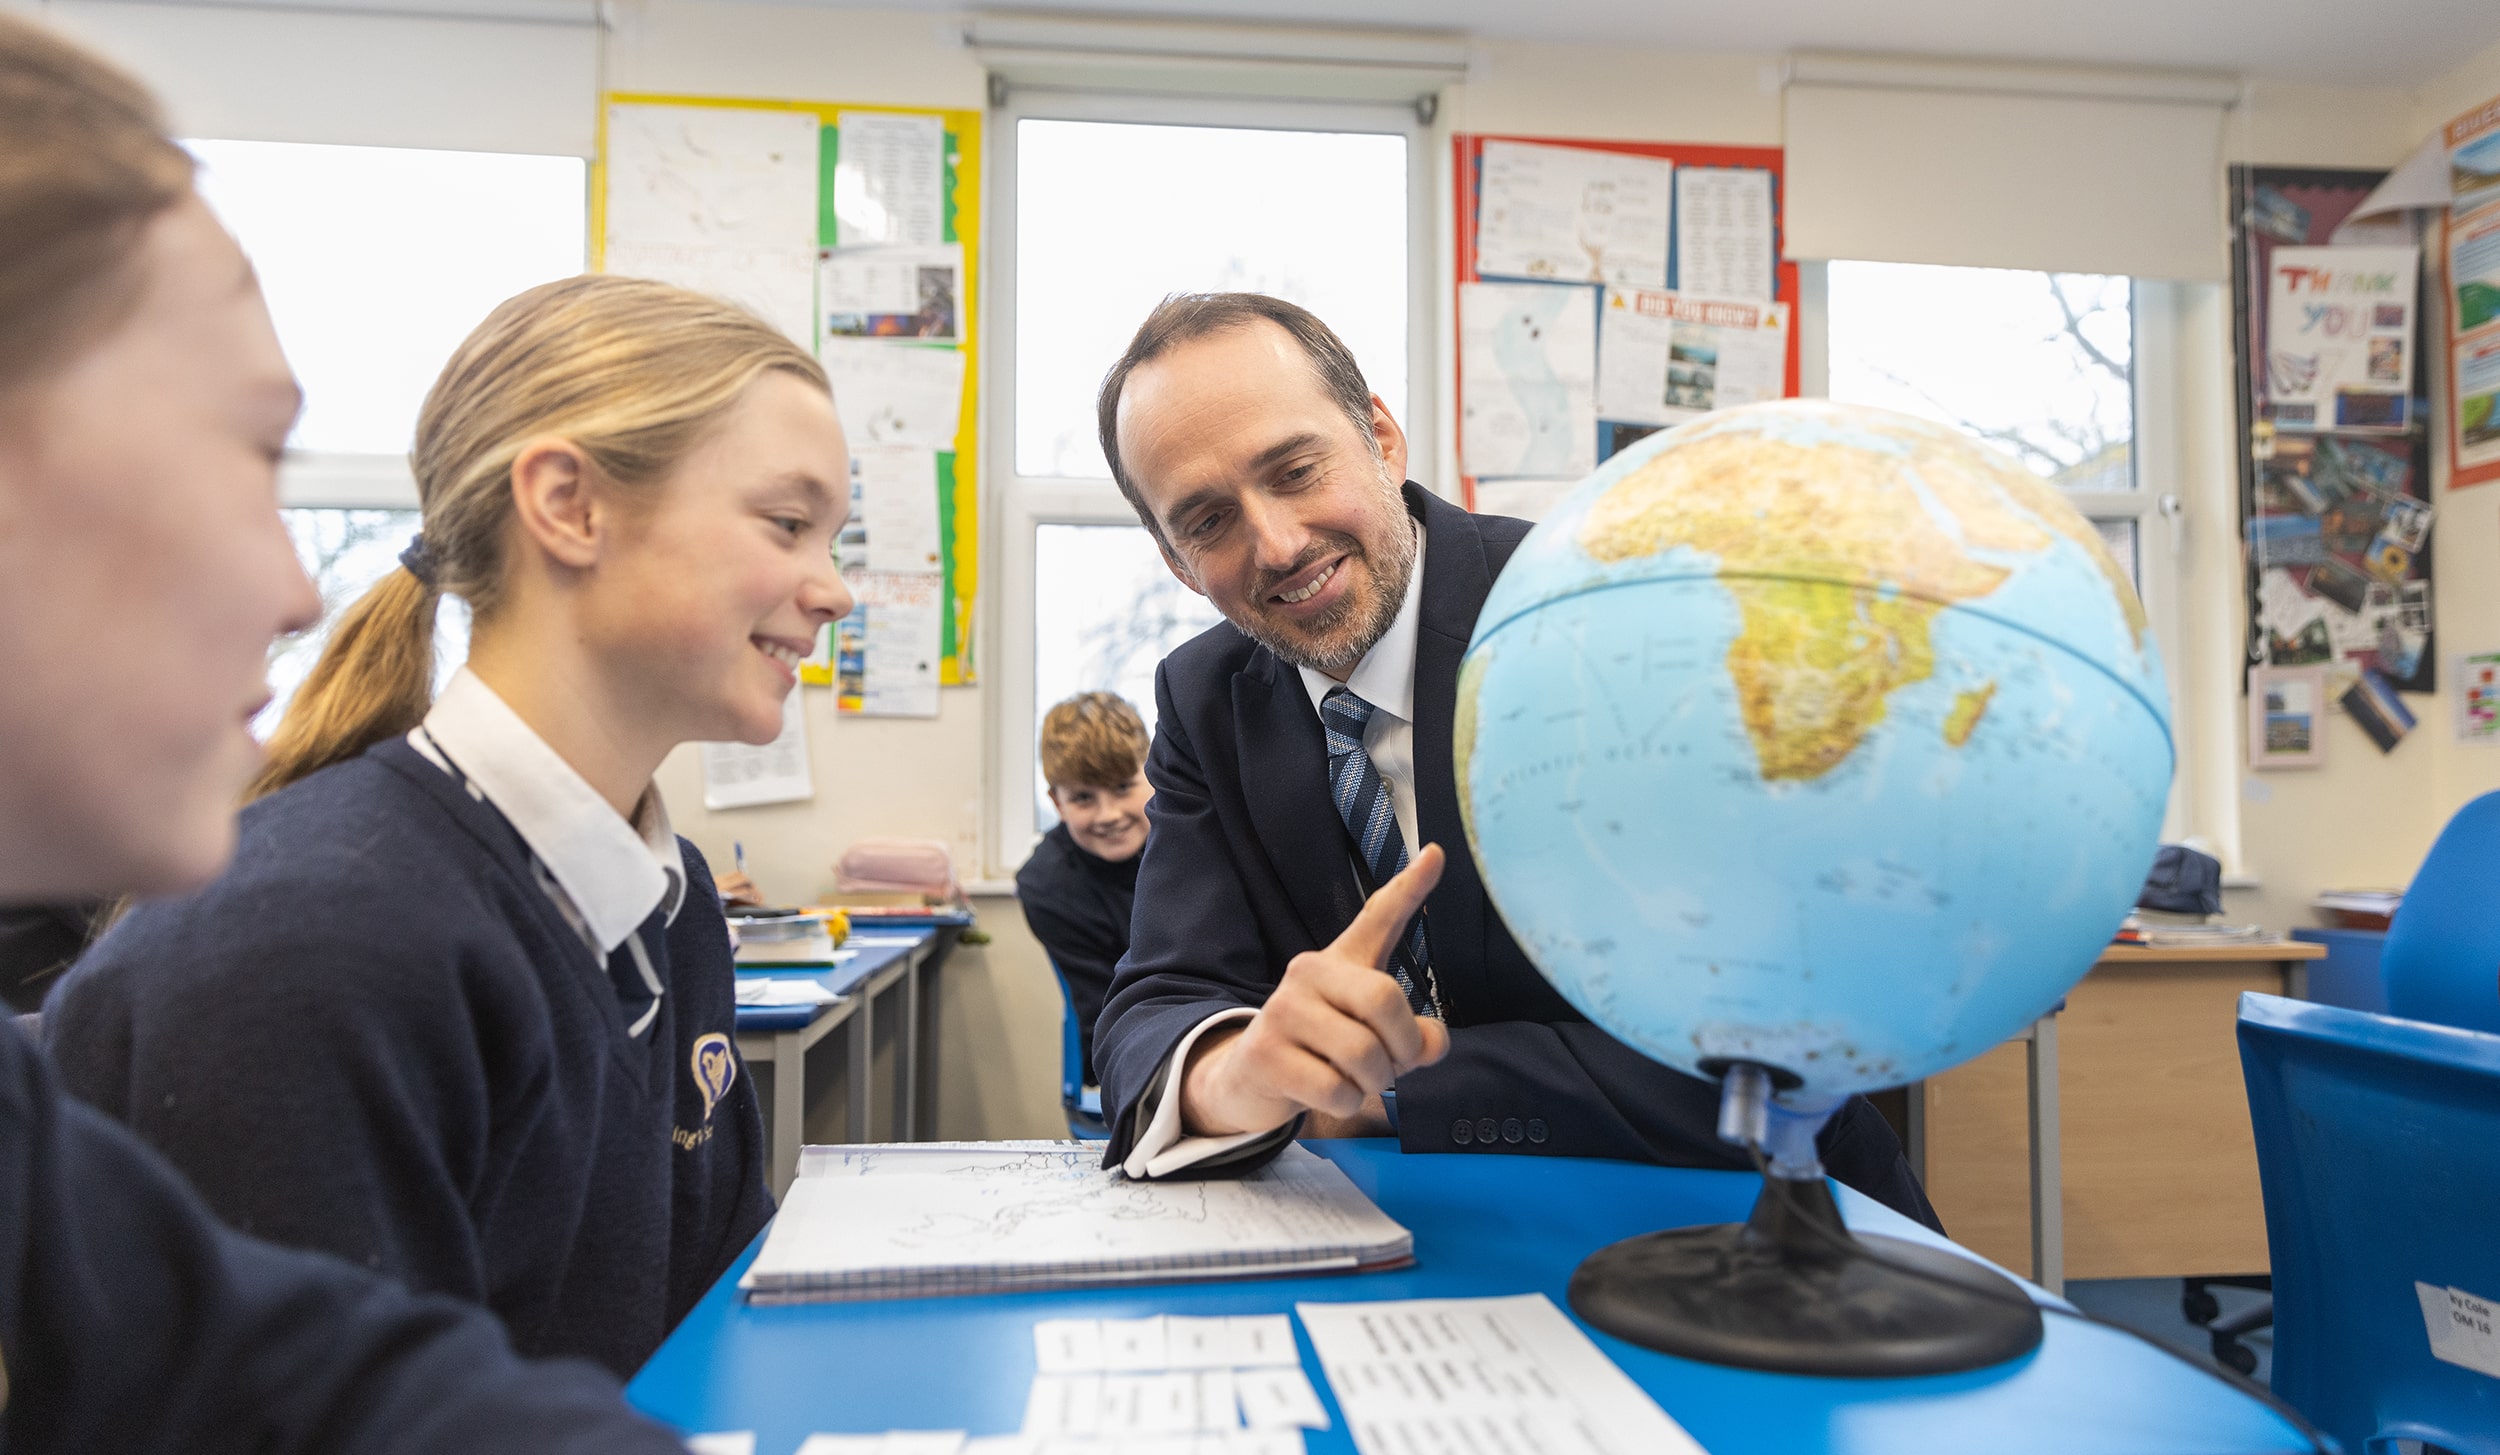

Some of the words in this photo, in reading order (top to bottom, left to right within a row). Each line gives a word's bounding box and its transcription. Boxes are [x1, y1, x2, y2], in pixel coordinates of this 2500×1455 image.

[2279, 266, 2397, 293] THANK
[2300, 304, 2368, 338] YOU
[2464, 1299, 2491, 1317] Cole
